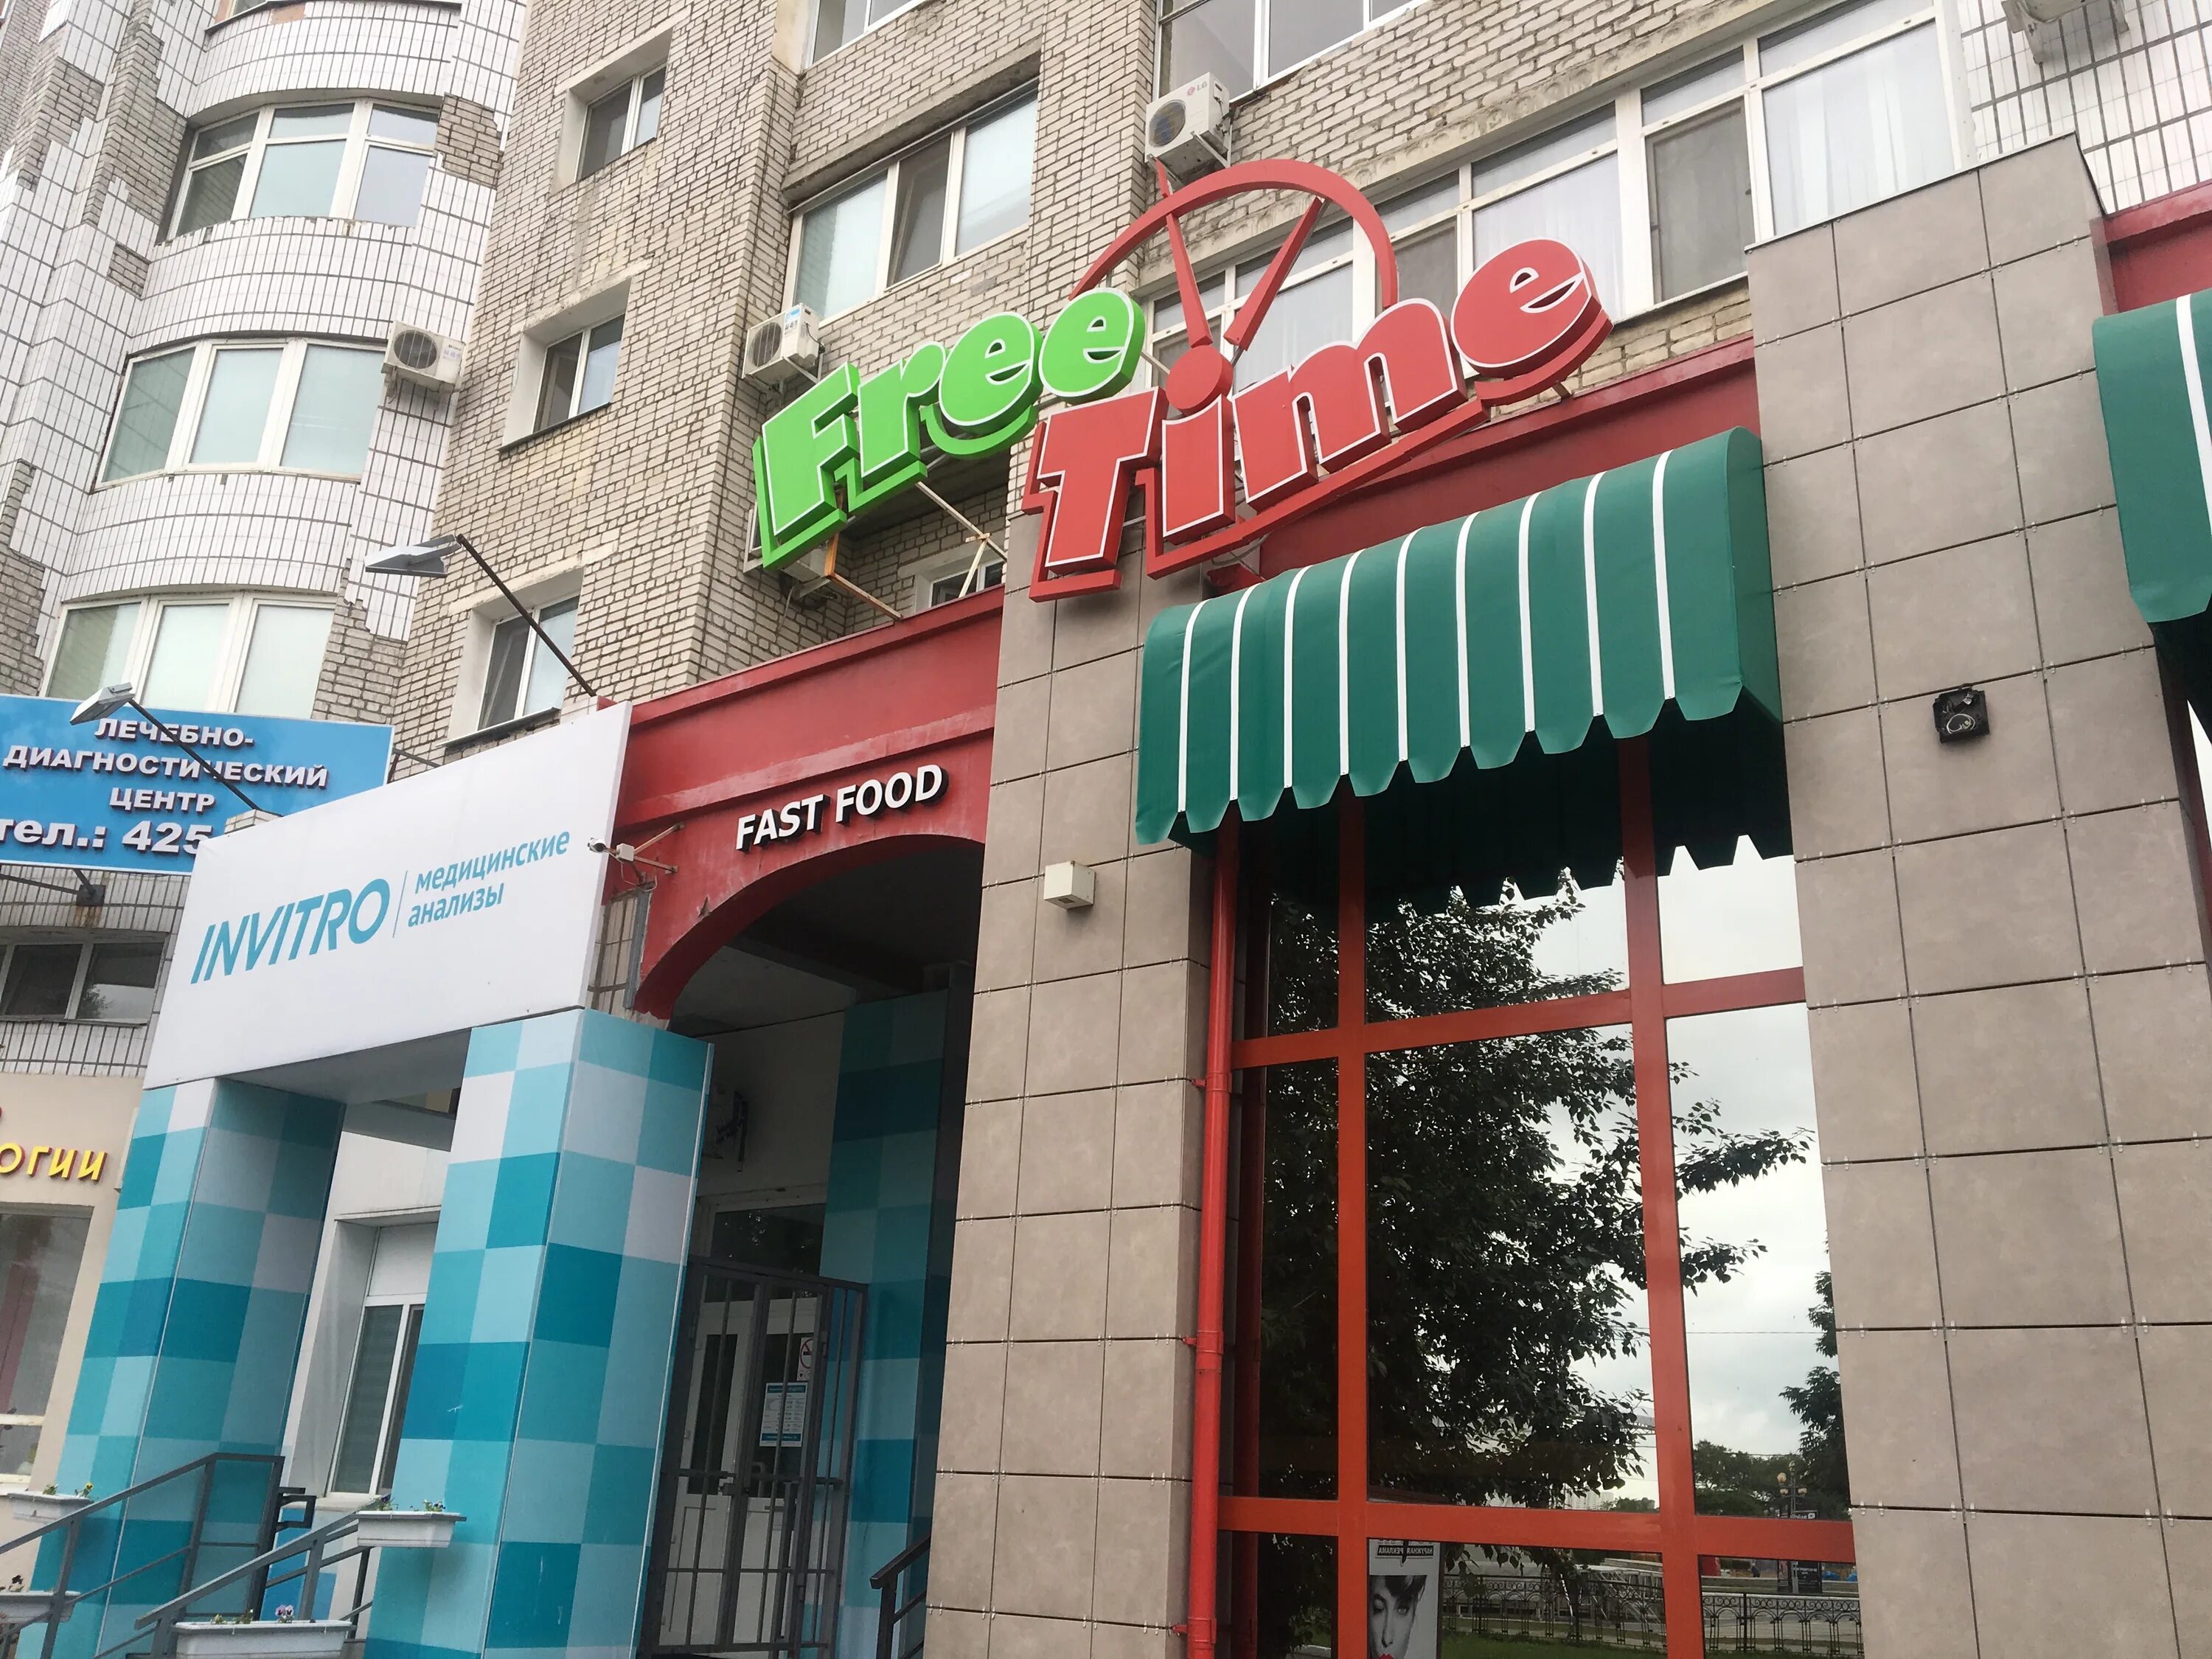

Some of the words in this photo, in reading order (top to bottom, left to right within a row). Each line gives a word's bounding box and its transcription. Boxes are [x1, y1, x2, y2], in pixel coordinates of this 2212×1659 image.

[754, 288, 1143, 569] Free
[1023, 238, 1613, 600] Time
[94, 718, 254, 747] ЛЕЧЕБНО-
[2, 745, 328, 787] ДИАГНОСТИЧЕСКИЙ
[109, 787, 215, 813] ЦЕНТР
[736, 794, 830, 852] FAST
[835, 764, 948, 825] FOOD
[414, 831, 570, 894] медицинские
[190, 878, 391, 984] INVITRO
[408, 883, 504, 928] анализы
